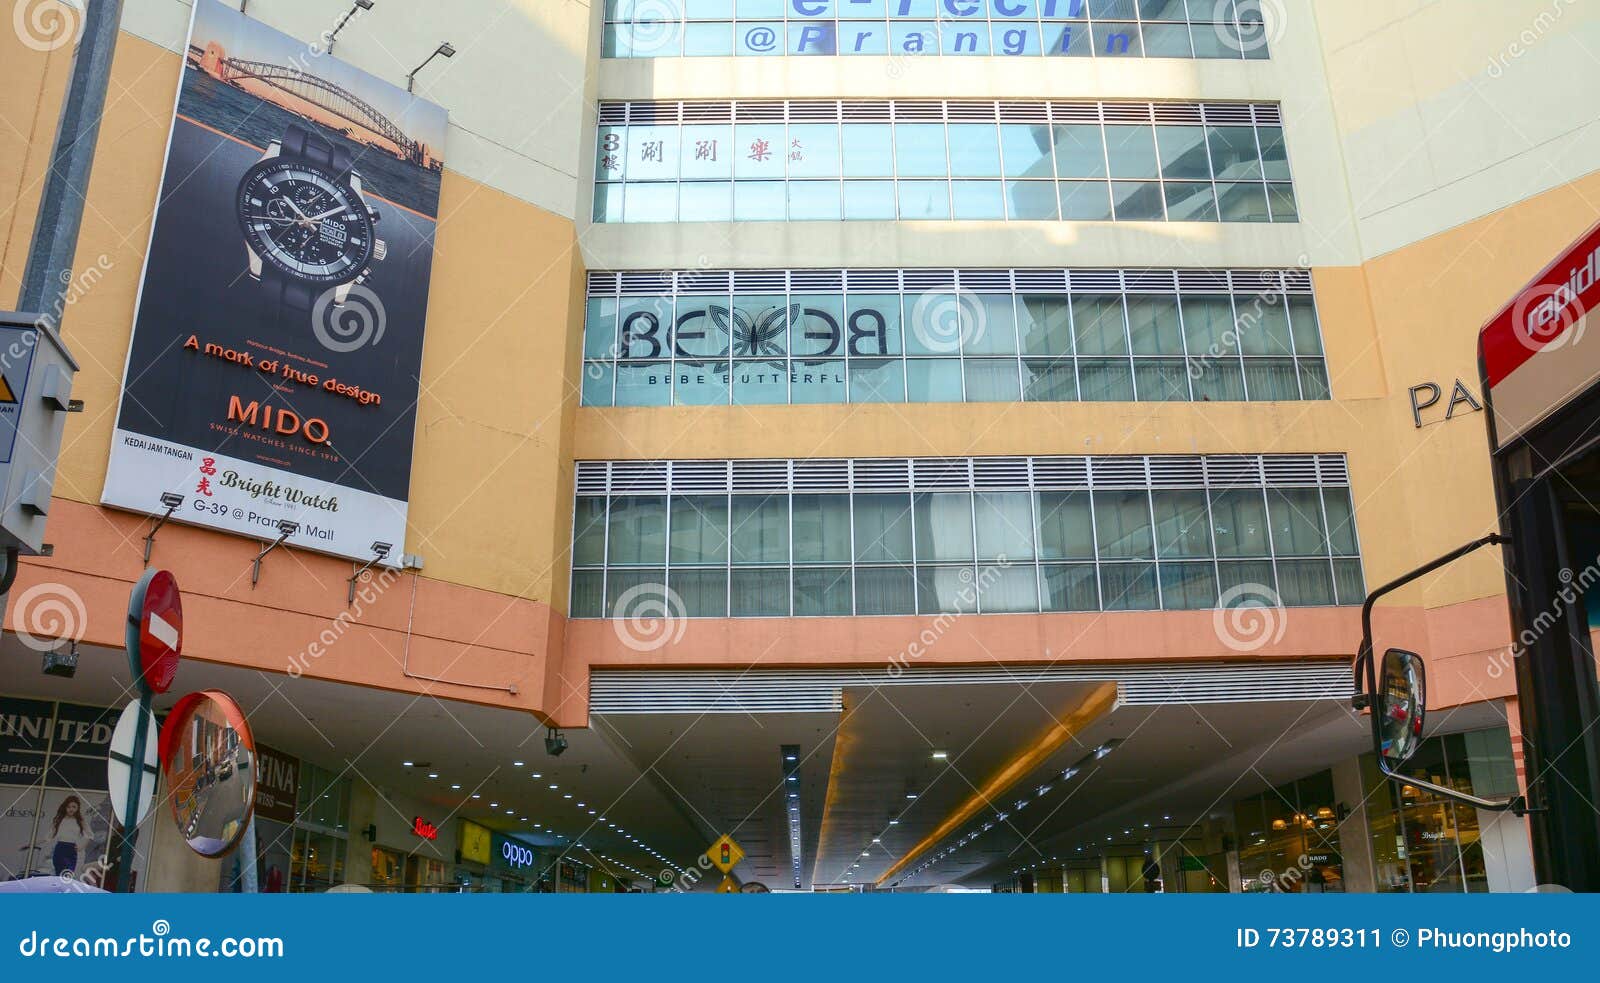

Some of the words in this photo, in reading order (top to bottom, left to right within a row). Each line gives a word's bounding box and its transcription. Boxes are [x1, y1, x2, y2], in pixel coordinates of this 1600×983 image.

[1527, 246, 1600, 336] rapid
[184, 334, 199, 350] A
[204, 342, 254, 367] mark
[259, 360, 279, 374] of
[282, 363, 319, 386] true
[323, 378, 381, 406] design
[124, 436, 147, 449] KEDAI
[147, 441, 163, 453] JAM
[162, 445, 193, 461] TANGAN
[209, 422, 239, 435] SWISS
[243, 431, 285, 448] WATCHES
[289, 444, 317, 457] SINCE
[319, 451, 340, 463] 1918
[220, 470, 281, 498] Bright
[284, 486, 339, 512] Watch
[193, 499, 228, 517] G-39
[232, 508, 244, 520] @
[248, 511, 300, 534] Pran
[306, 524, 334, 541] Mall
[0, 762, 44, 775] artner
